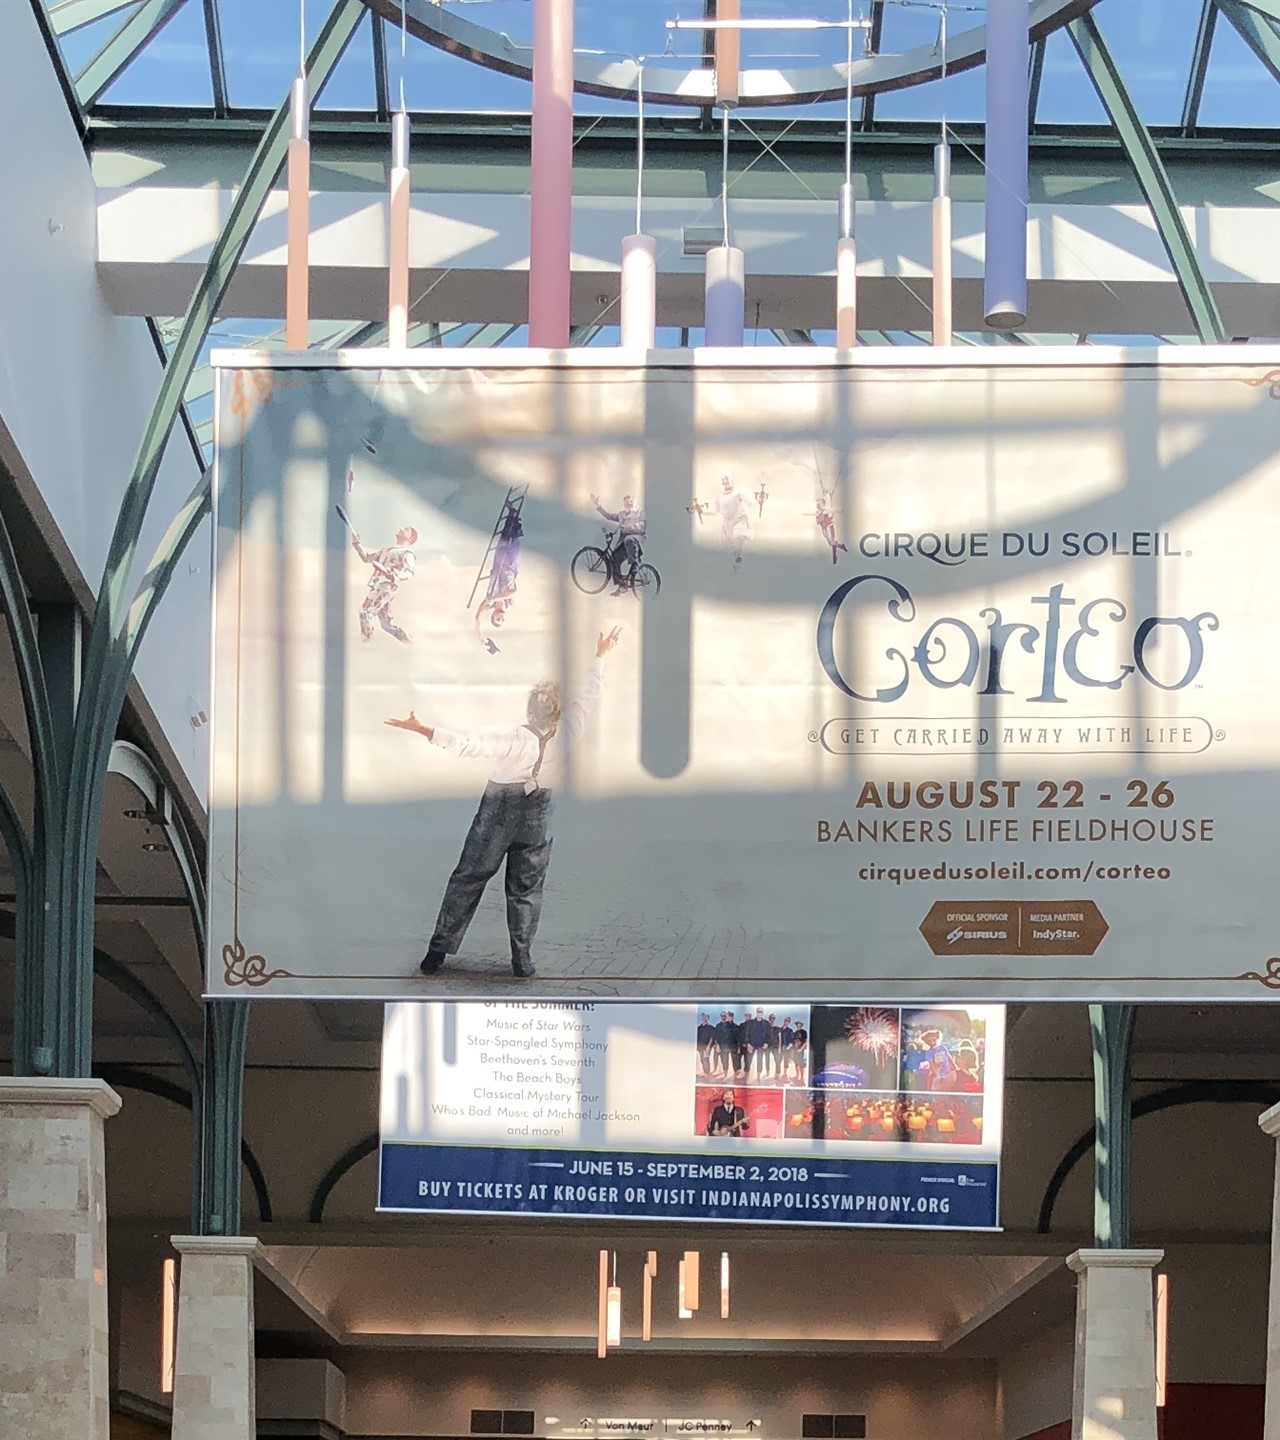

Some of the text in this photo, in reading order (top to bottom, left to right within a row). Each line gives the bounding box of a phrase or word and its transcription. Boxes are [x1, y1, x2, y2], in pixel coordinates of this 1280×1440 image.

[859, 532, 988, 566] CIRQUE
[1002, 532, 1050, 557] DU
[841, 727, 1194, 746] GET CARRIED AWAY WITH LIFE
[856, 779, 1175, 810] AUGUST 22 - 26
[817, 818, 1214, 843] BANKERS LIFE FIELDHOUSE
[858, 861, 1171, 886] cirquedusoleil.com/corteo
[947, 913, 1008, 922] OFFICIAL SPONSOR
[1030, 913, 1084, 922] MEDIA PARTNER
[486, 1018, 591, 1032] Music of Star Wars
[467, 1035, 609, 1053] Star-Spangled Symphony
[550, 1055, 595, 1067] Seventh
[492, 1071, 582, 1086] The Beach Boys
[473, 1088, 600, 1104] Classical Mystery Tour
[431, 1104, 465, 1116] Whos
[497, 1106, 529, 1119] Music
[532, 1107, 544, 1119] of
[547, 1108, 592, 1120] Michael
[594, 1110, 640, 1122] Jackson
[507, 1126, 564, 1137] and more!
[569, 1160, 613, 1176] JUNE
[616, 1161, 634, 1176] 15
[646, 1162, 745, 1180] SEPTEMBER
[749, 1166, 765, 1182] 2,
[768, 1167, 808, 1182] 2018
[419, 1180, 950, 1213] BUY TICKETS AT KROGER OR VISIT INDIANAPOLISSYMPHONY.ORG
[605, 1421, 655, 1430] Von Maur
[678, 1421, 733, 1433] JC Penney
